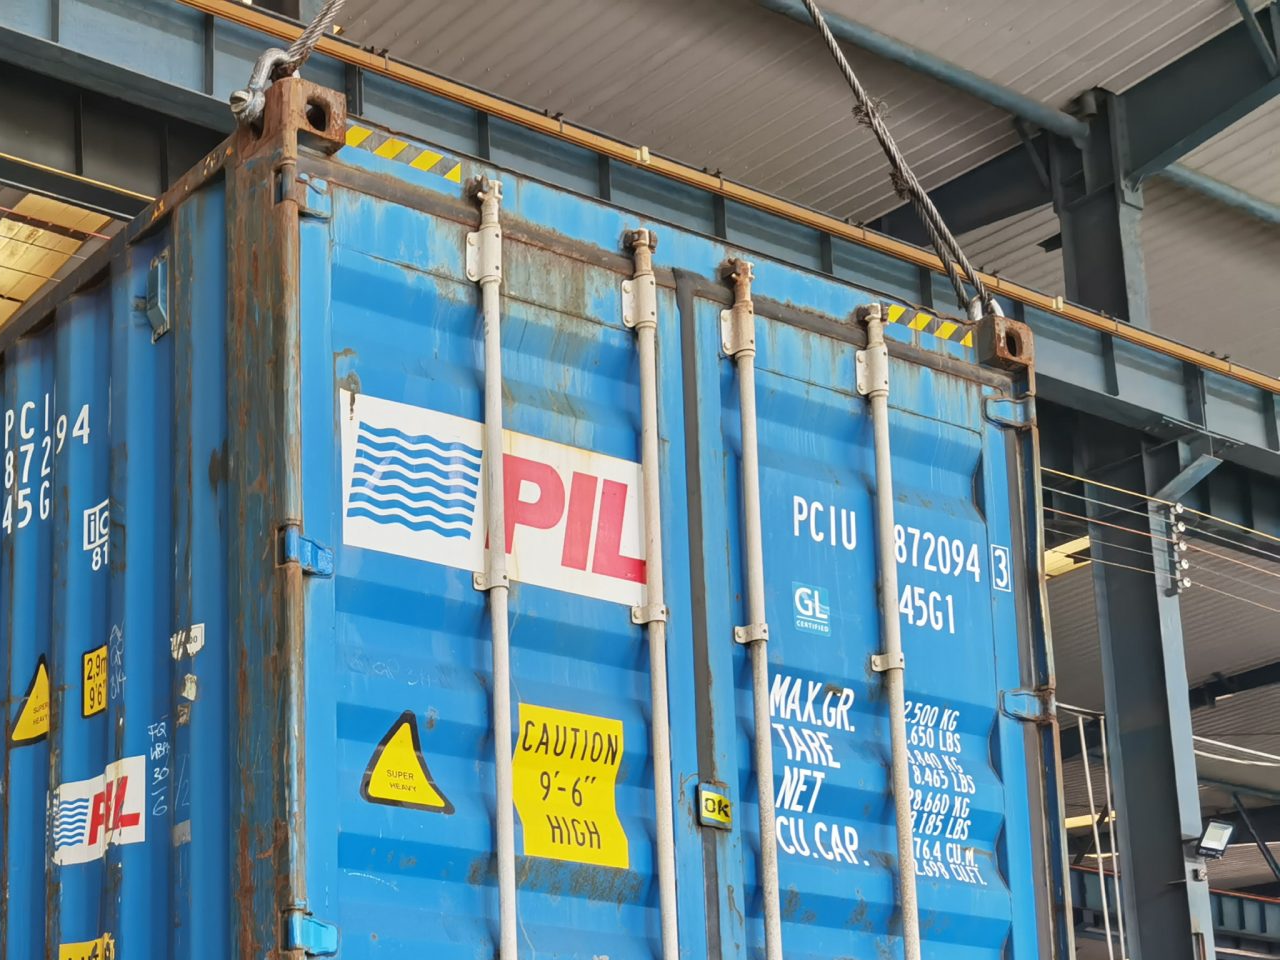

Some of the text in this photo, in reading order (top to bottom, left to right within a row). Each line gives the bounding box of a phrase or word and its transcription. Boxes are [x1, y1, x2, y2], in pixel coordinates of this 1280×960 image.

[485, 453, 647, 585] PIL
[793, 495, 1009, 588] PCIU 872094 3
[794, 587, 828, 619] GL
[796, 619, 830, 633] CERTIFIED
[899, 584, 956, 634] 45G1
[770, 674, 856, 732] MAX.GR.
[939, 709, 960, 731] KG
[522, 720, 618, 766] CAUTION
[771, 723, 841, 769] TARE
[941, 754, 964, 773] KG
[939, 730, 961, 753] LBS
[386, 769, 414, 780] SUPER
[389, 782, 417, 792] HEAVY
[775, 765, 825, 814] NET
[952, 796, 971, 818] KG
[951, 772, 976, 794] LBS
[88, 775, 141, 846] PIL
[546, 814, 602, 850] HIGH
[945, 817, 972, 840] LBS
[775, 816, 870, 867] CU.CAP.
